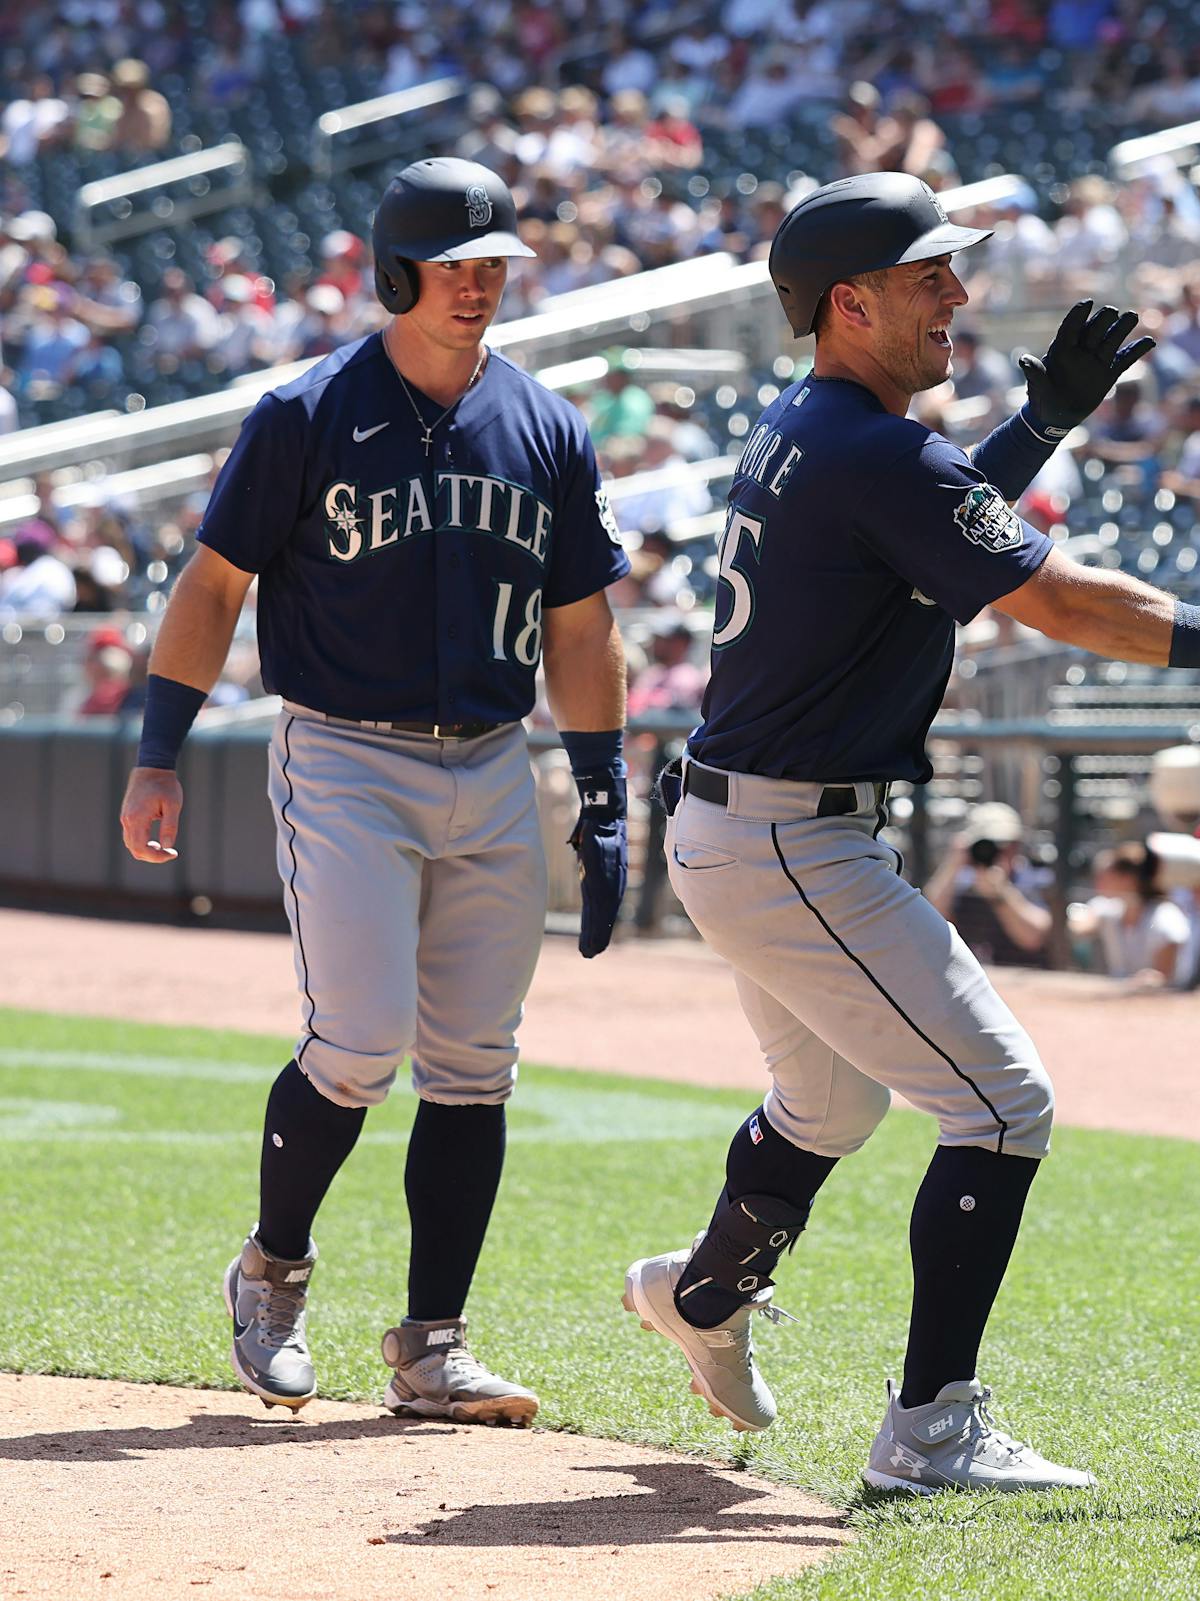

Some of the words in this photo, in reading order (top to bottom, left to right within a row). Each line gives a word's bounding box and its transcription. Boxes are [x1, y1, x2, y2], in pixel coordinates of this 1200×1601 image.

[735, 424, 803, 496] OORE
[325, 473, 552, 562] SEATTLE
[970, 517, 991, 541] ALL
[985, 510, 1010, 539] GAME
[714, 503, 762, 646] 5
[493, 583, 543, 666] 18
[284, 1267, 311, 1283] NIKE
[426, 1327, 457, 1346] NIKE
[928, 1414, 954, 1438] BH
